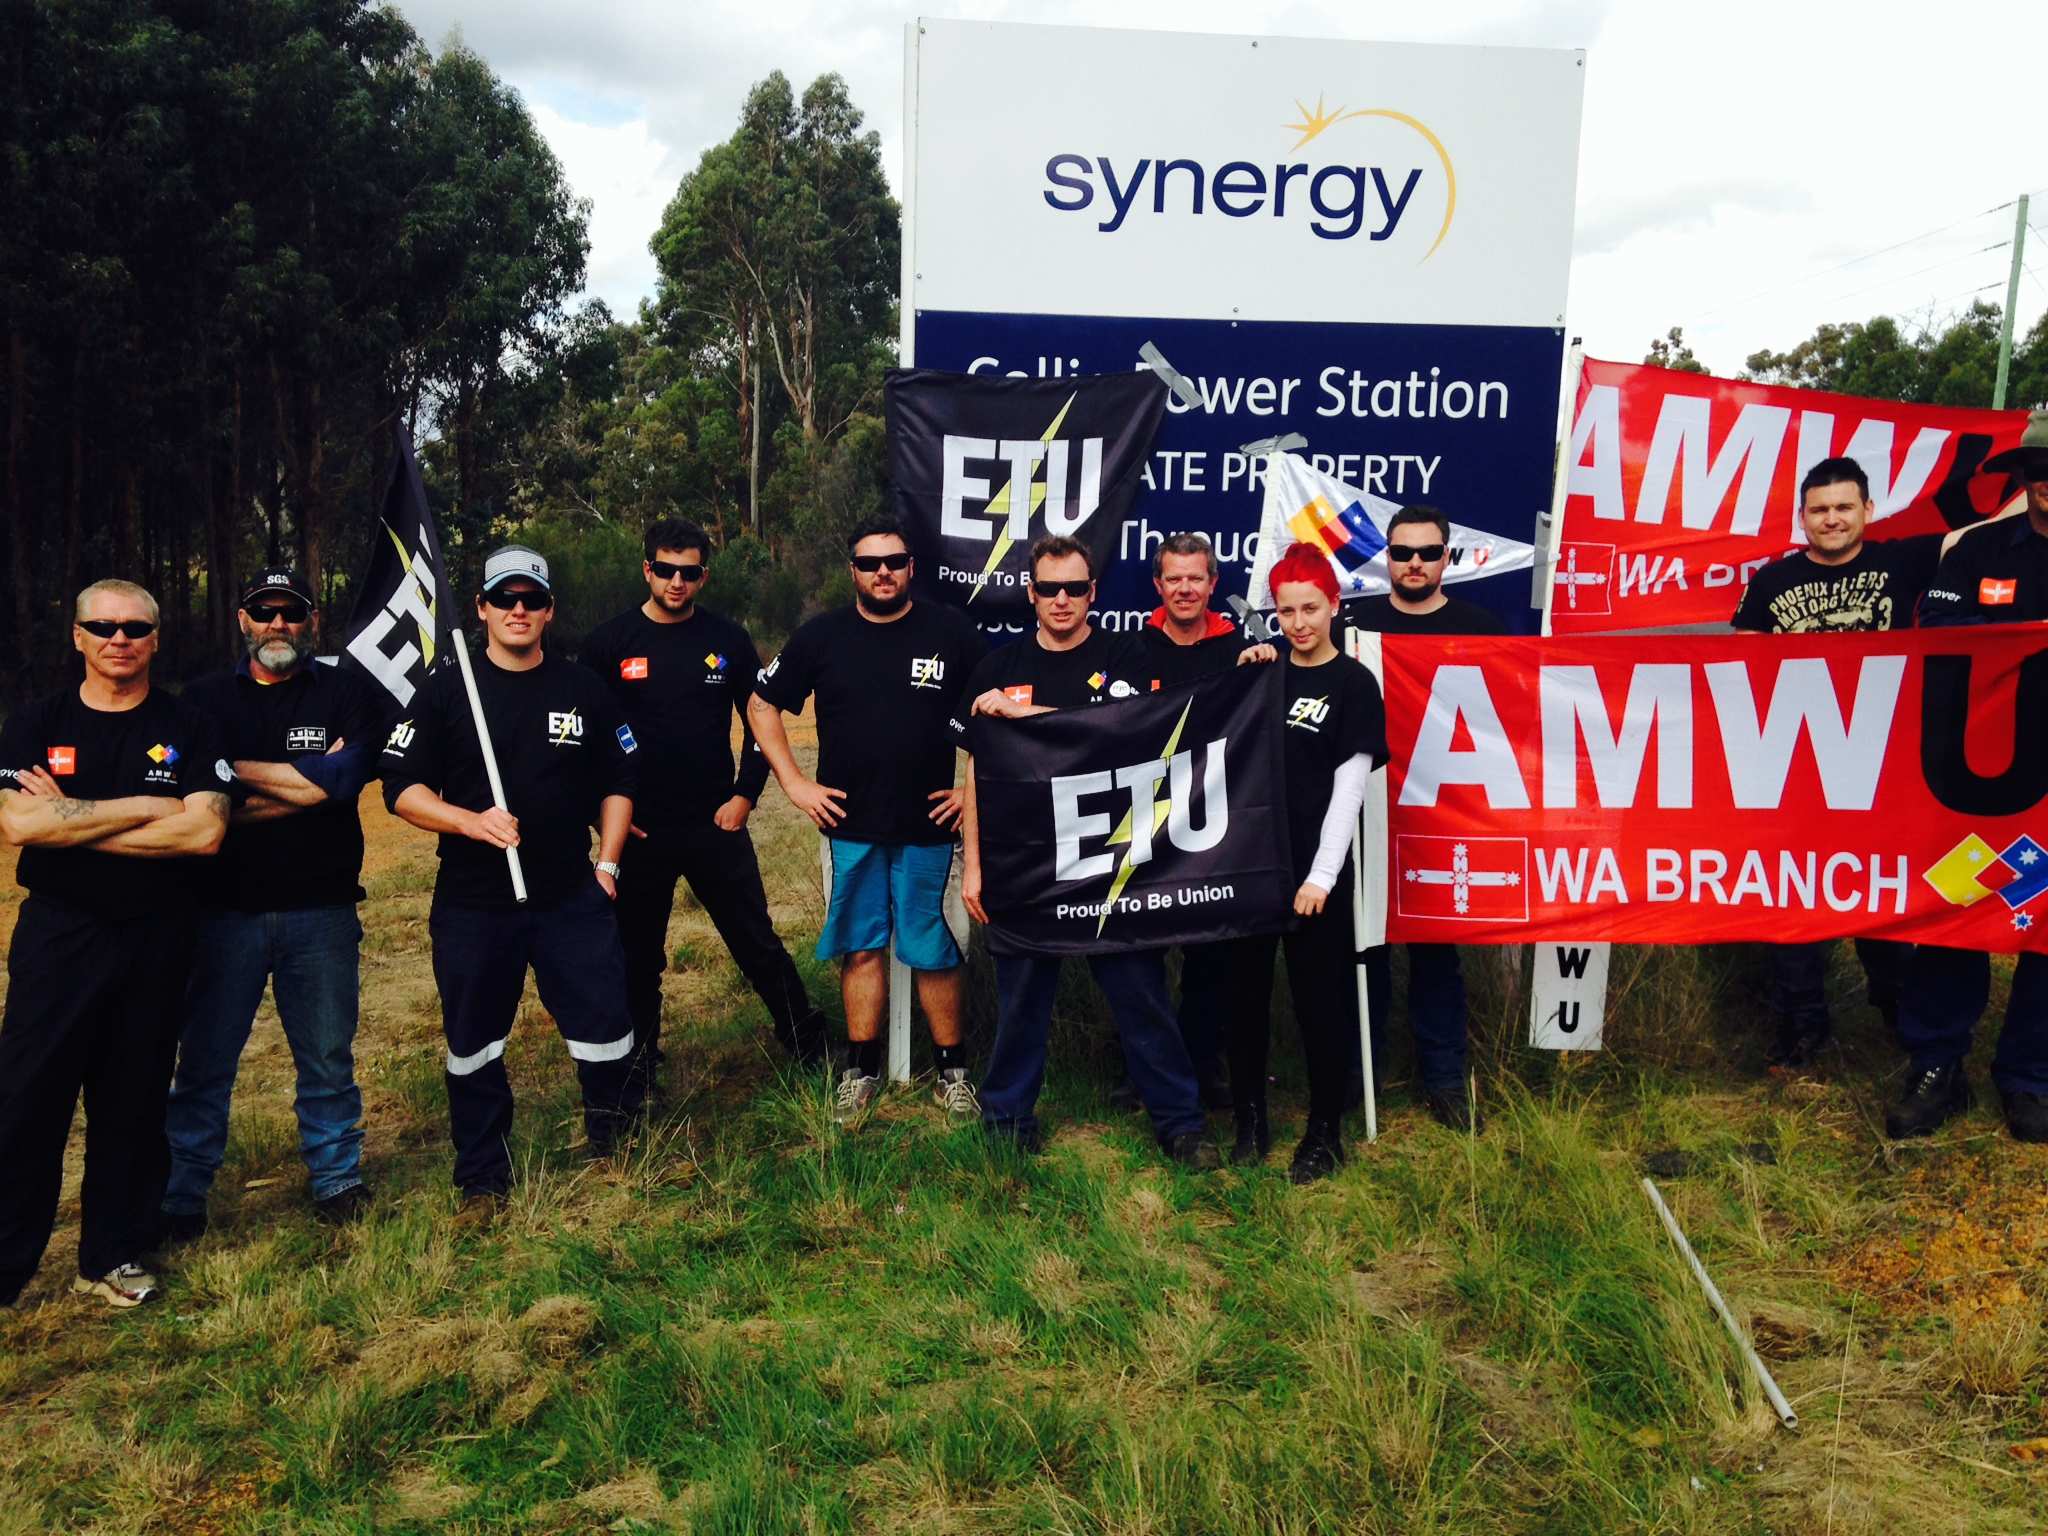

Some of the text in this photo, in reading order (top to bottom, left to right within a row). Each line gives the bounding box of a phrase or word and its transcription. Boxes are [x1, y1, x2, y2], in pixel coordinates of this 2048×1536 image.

[1043, 153, 1423, 242] synergy
[1135, 361, 1509, 419] ower Station
[941, 434, 1104, 541] ETU
[1221, 451, 1442, 495] PRPERTY
[266, 574, 289, 585] SGS
[938, 566, 988, 587] Proud
[994, 568, 1015, 587] To
[1618, 553, 1688, 598] WA
[1768, 580, 1829, 617] PHOENIX
[1776, 590, 1881, 630] MOTORCYCLE
[911, 658, 945, 681] ETU
[548, 711, 584, 737] ETU
[1288, 697, 1330, 724] ETU
[1397, 654, 2048, 817] AMWU
[1050, 736, 1229, 882] ETU
[1534, 847, 1908, 914] WA BRANCH
[1056, 884, 1235, 920] Proud To Be Union
